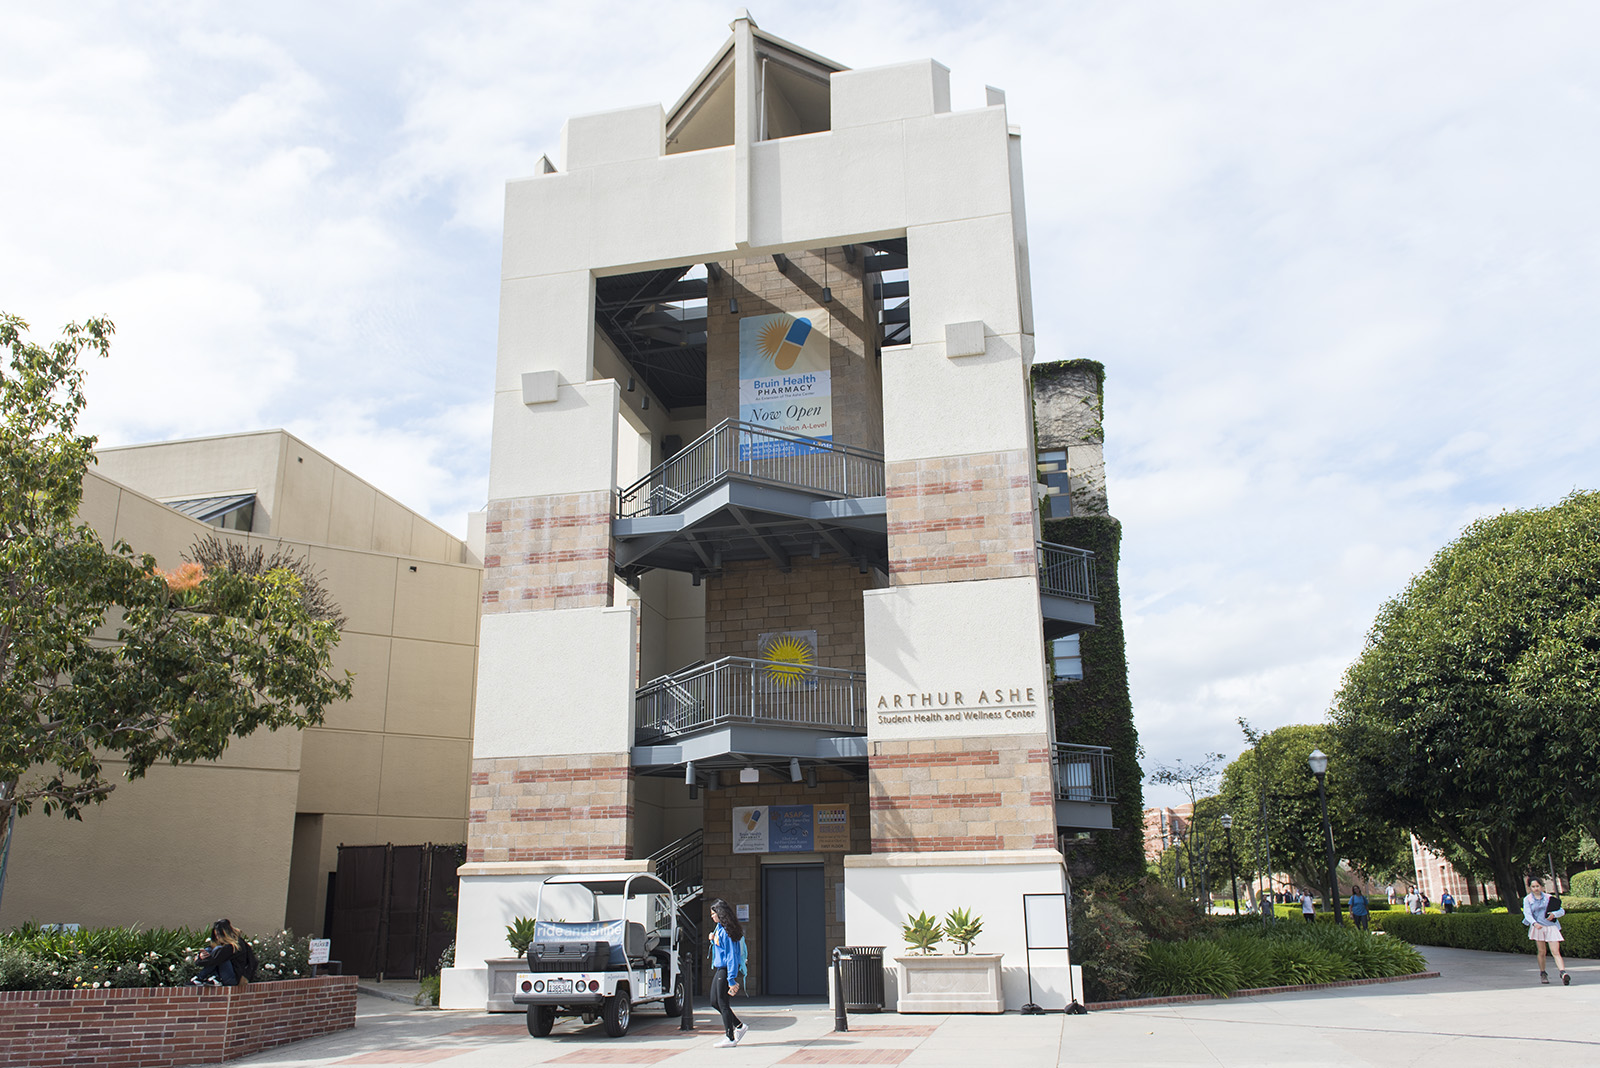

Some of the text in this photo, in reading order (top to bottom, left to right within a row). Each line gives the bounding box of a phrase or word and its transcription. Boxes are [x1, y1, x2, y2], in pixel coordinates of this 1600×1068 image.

[753, 374, 816, 389] Bruin Health
[757, 384, 813, 396] PHARMACY
[749, 404, 822, 422] Now Open
[801, 421, 828, 430] A-Level
[877, 687, 1035, 708] ARTHUR ASHE
[878, 708, 1035, 724] Student Health and Wellness Center
[783, 810, 802, 818] ASAP
